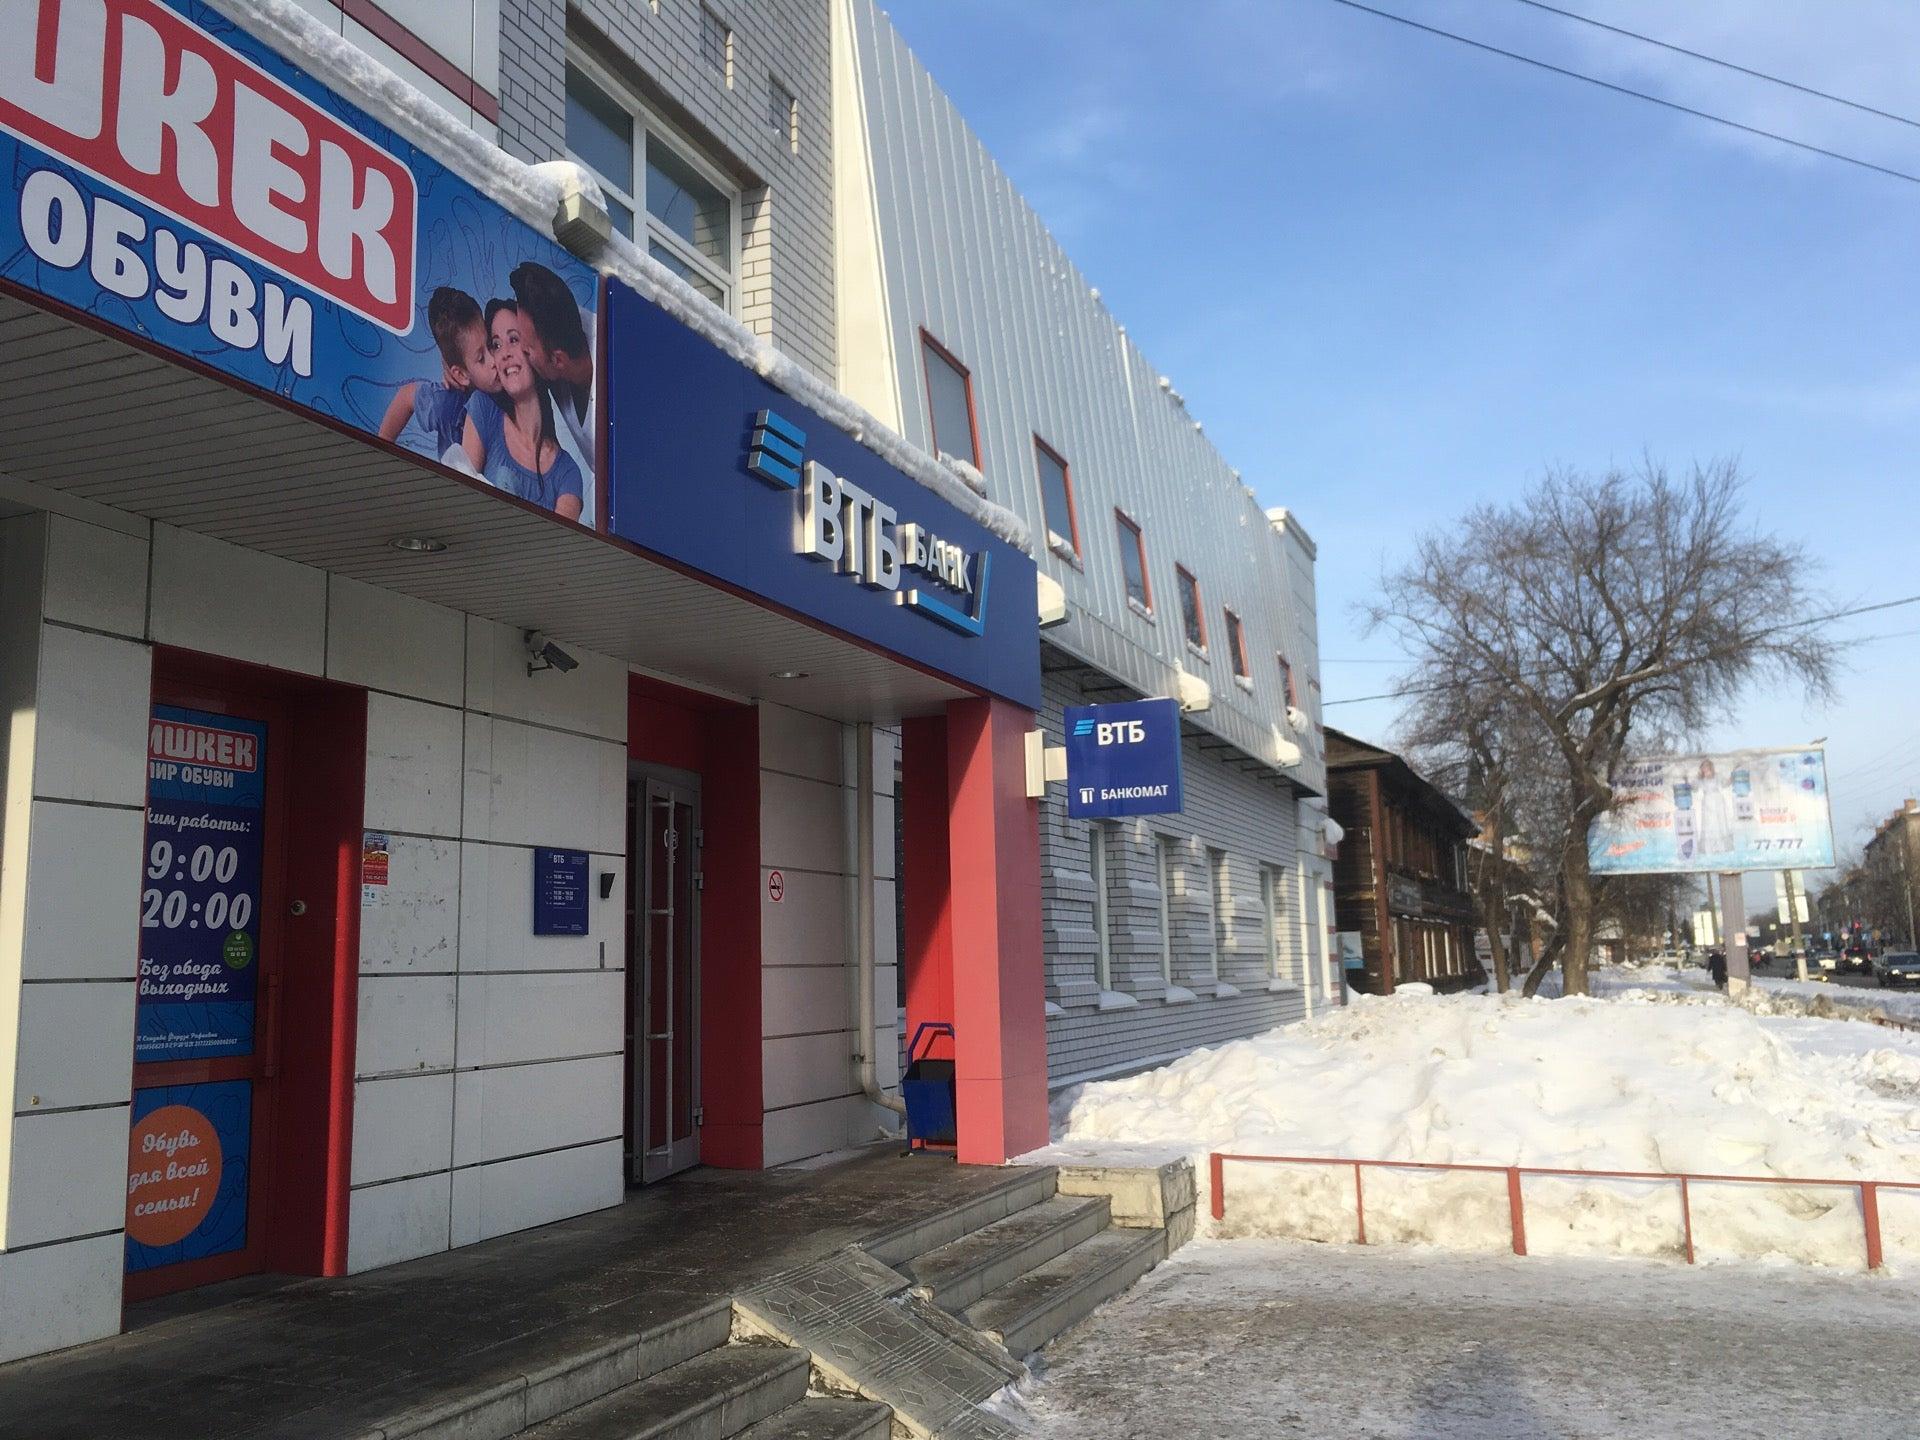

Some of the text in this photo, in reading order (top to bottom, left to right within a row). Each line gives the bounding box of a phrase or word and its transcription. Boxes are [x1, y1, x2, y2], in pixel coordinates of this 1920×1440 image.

[20, 169, 313, 378] ОБУВИ
[803, 460, 901, 592] ВТБ
[904, 523, 972, 594] БАНК
[1097, 720, 1146, 745] ВТБ
[181, 766, 234, 788] ОБУВИ
[1101, 785, 1169, 800] БАНКОМАТ
[178, 813, 251, 833] работы:
[147, 840, 239, 884] 9:00
[142, 888, 252, 930] 20:00
[139, 958, 222, 982] Без обеда
[139, 979, 229, 1001] выходных
[142, 1130, 201, 1158] Обувь
[166, 1158, 209, 1182] всей
[134, 1187, 200, 1217] семьи!
